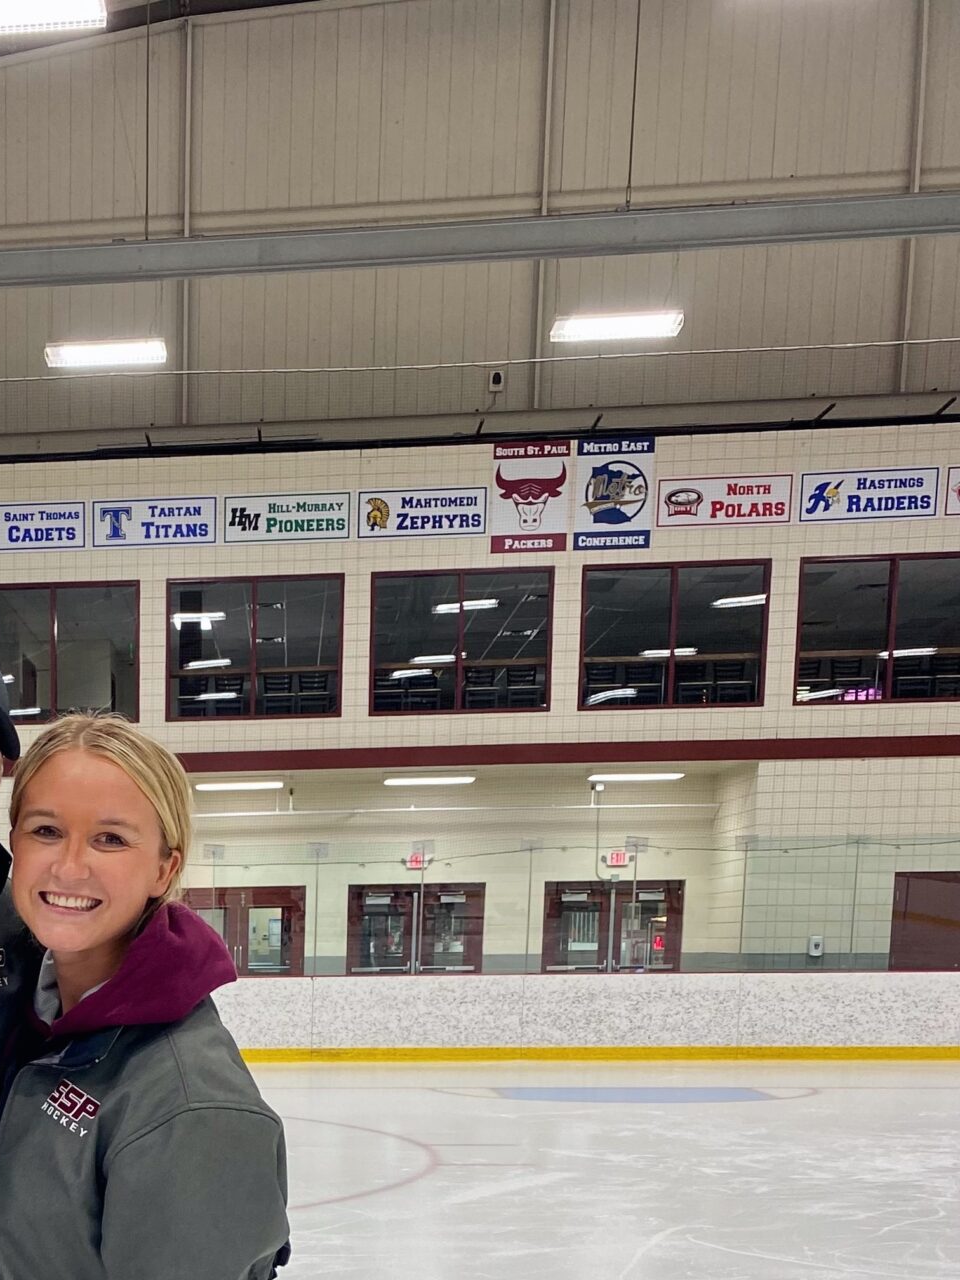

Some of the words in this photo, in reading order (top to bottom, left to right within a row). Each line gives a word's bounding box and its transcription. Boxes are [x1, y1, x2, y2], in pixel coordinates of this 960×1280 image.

[495, 446, 525, 457] SOUTH
[544, 445, 568, 454] PAUL
[583, 442, 619, 453] METRO
[621, 441, 649, 452] EAST
[726, 483, 771, 496] NORTH
[856, 477, 924, 490] HASTINGS
[268, 501, 344, 514] HILL-MURRAY
[401, 496, 478, 509] MAHTOMEDI
[846, 494, 931, 513] RAIDERS
[4, 512, 34, 522] SAINT
[38, 510, 80, 521] THOMAS
[148, 505, 202, 518] TARTAN
[710, 501, 786, 519] POLARS
[266, 517, 345, 534] PIONEERS
[396, 512, 481, 531] ZEPHYRS
[7, 525, 76, 543] CADETS
[141, 521, 209, 539] TITANS
[504, 538, 553, 549] PACKERS
[578, 535, 645, 547] CONFERENCE
[47, 1078, 101, 1122] SSP
[41, 1101, 88, 1138] HOCKEY
